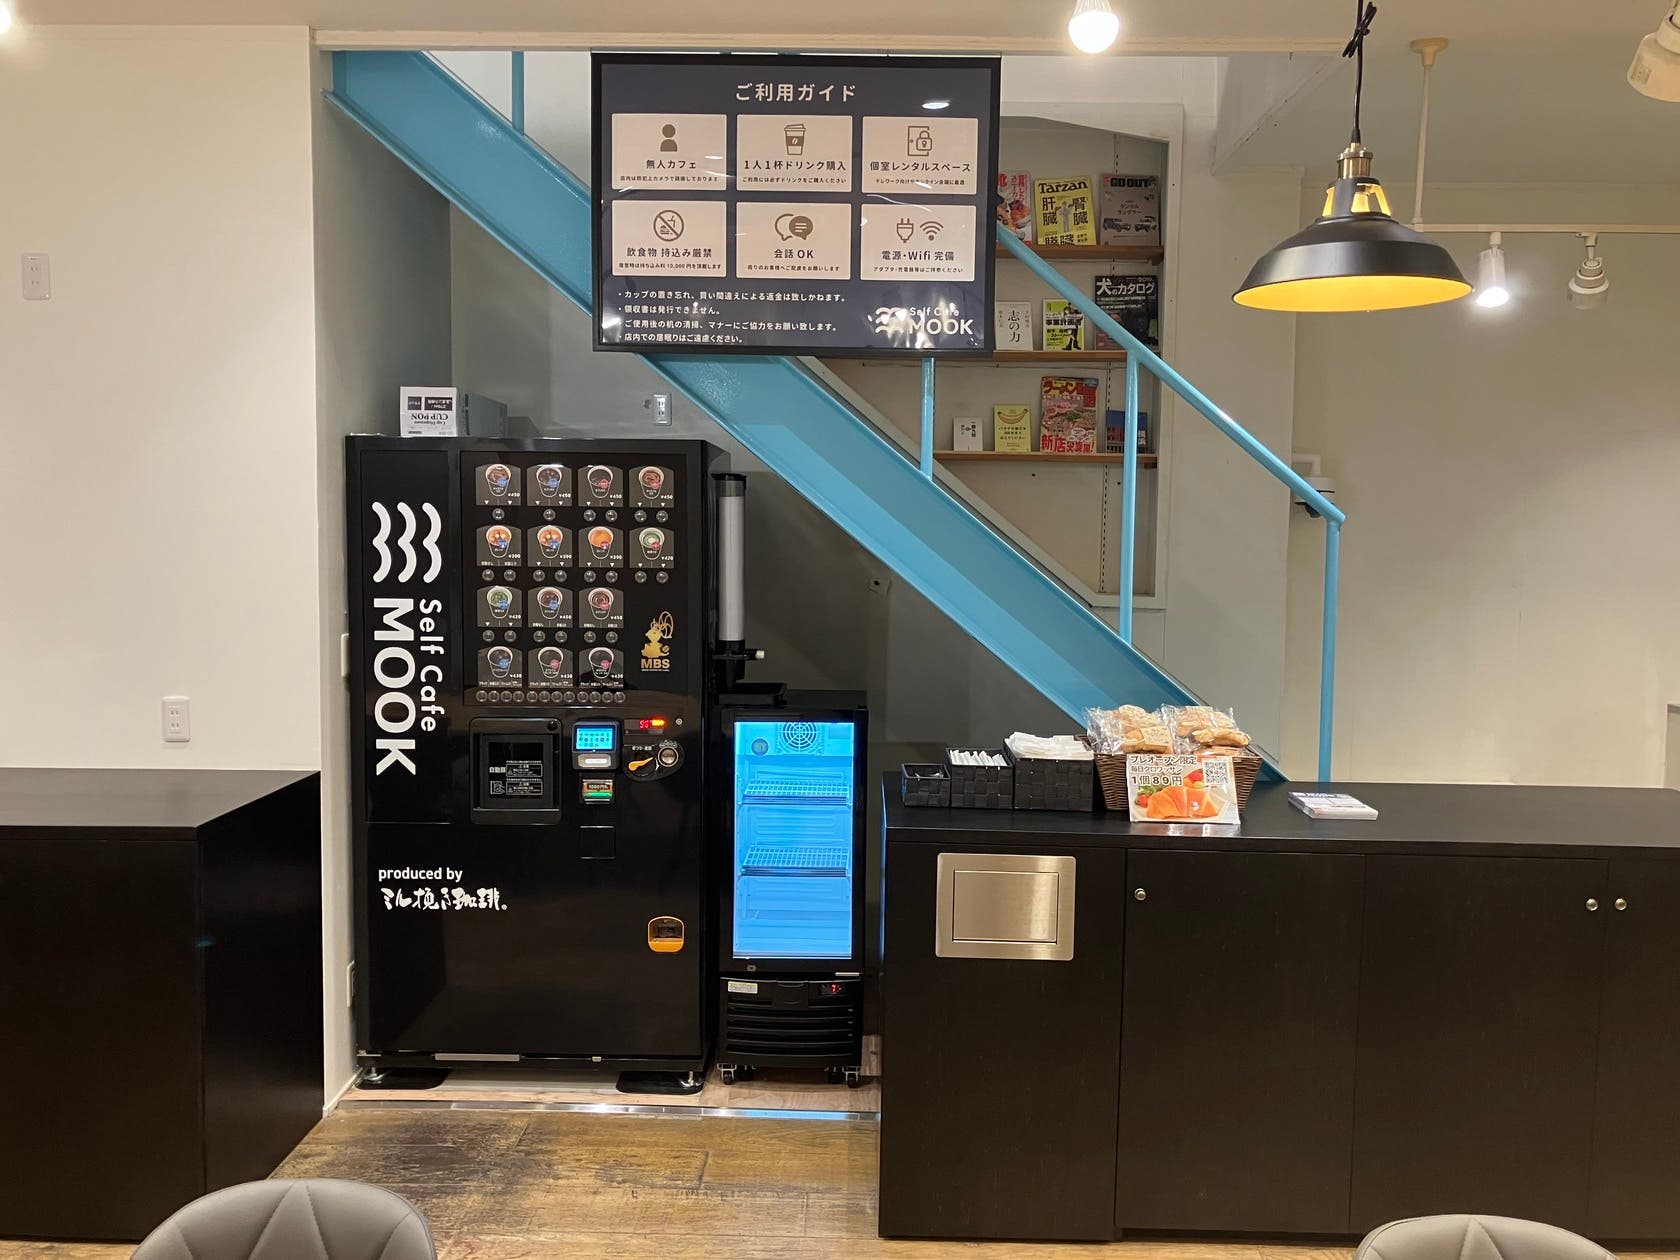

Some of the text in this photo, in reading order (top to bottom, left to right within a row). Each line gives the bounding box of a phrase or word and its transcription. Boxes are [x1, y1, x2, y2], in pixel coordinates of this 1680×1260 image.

[736, 83, 855, 102] ご利用ガイド
[646, 159, 696, 169] 無人カフェ
[744, 160, 846, 171] 1人1杯ドリンク購入
[870, 161, 970, 172] 個室レンタルスペース
[1038, 180, 1088, 194] Tarzan
[1042, 196, 1058, 226] 肝臓
[627, 247, 712, 258] 飲食物 持込み厳禁
[774, 249, 814, 259] 会話 OK
[934, 251, 954, 261] 完備
[1096, 278, 1154, 296] 犬のカタログ
[934, 306, 959, 317] Ce
[909, 318, 974, 335] MOOK
[1008, 309, 1021, 343] 志の力
[419, 598, 445, 732] Self Cafe
[641, 659, 670, 669] MBS
[374, 598, 416, 776] MOOK
[1130, 755, 1197, 765] プレオープン限定
[1131, 775, 1182, 785] 1個89円
[379, 867, 463, 882] produced by
